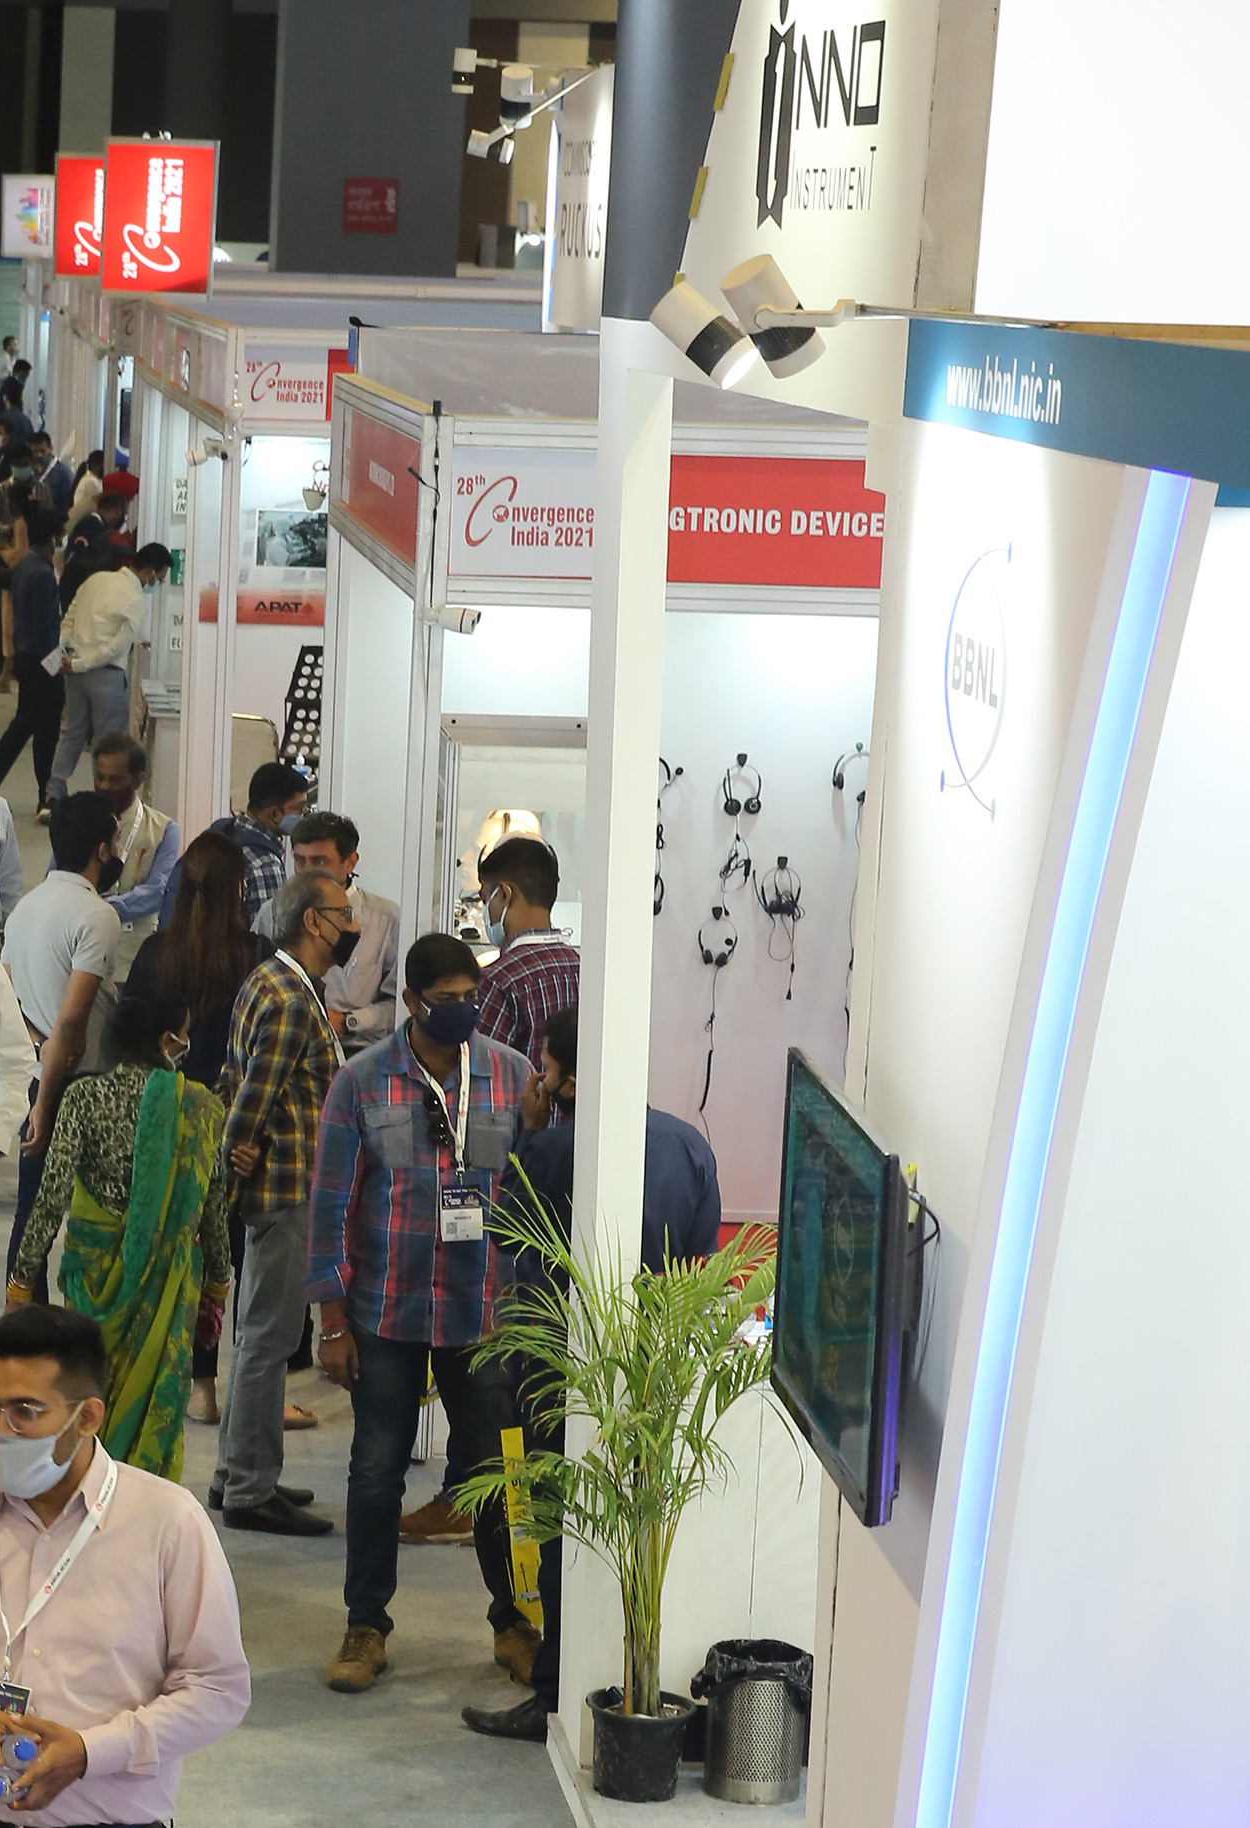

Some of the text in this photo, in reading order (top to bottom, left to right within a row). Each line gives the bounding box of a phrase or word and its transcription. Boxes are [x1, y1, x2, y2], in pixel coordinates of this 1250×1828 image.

[560, 203, 602, 259] RUCKUS
[277, 391, 324, 404] India 2021
[946, 355, 1062, 425] www.bbnl.nic.in
[457, 475, 486, 496] 28th
[511, 526, 594, 548] India 2021
[669, 506, 885, 538] GTRONIC DEVICE
[952, 633, 998, 709] BBNL
